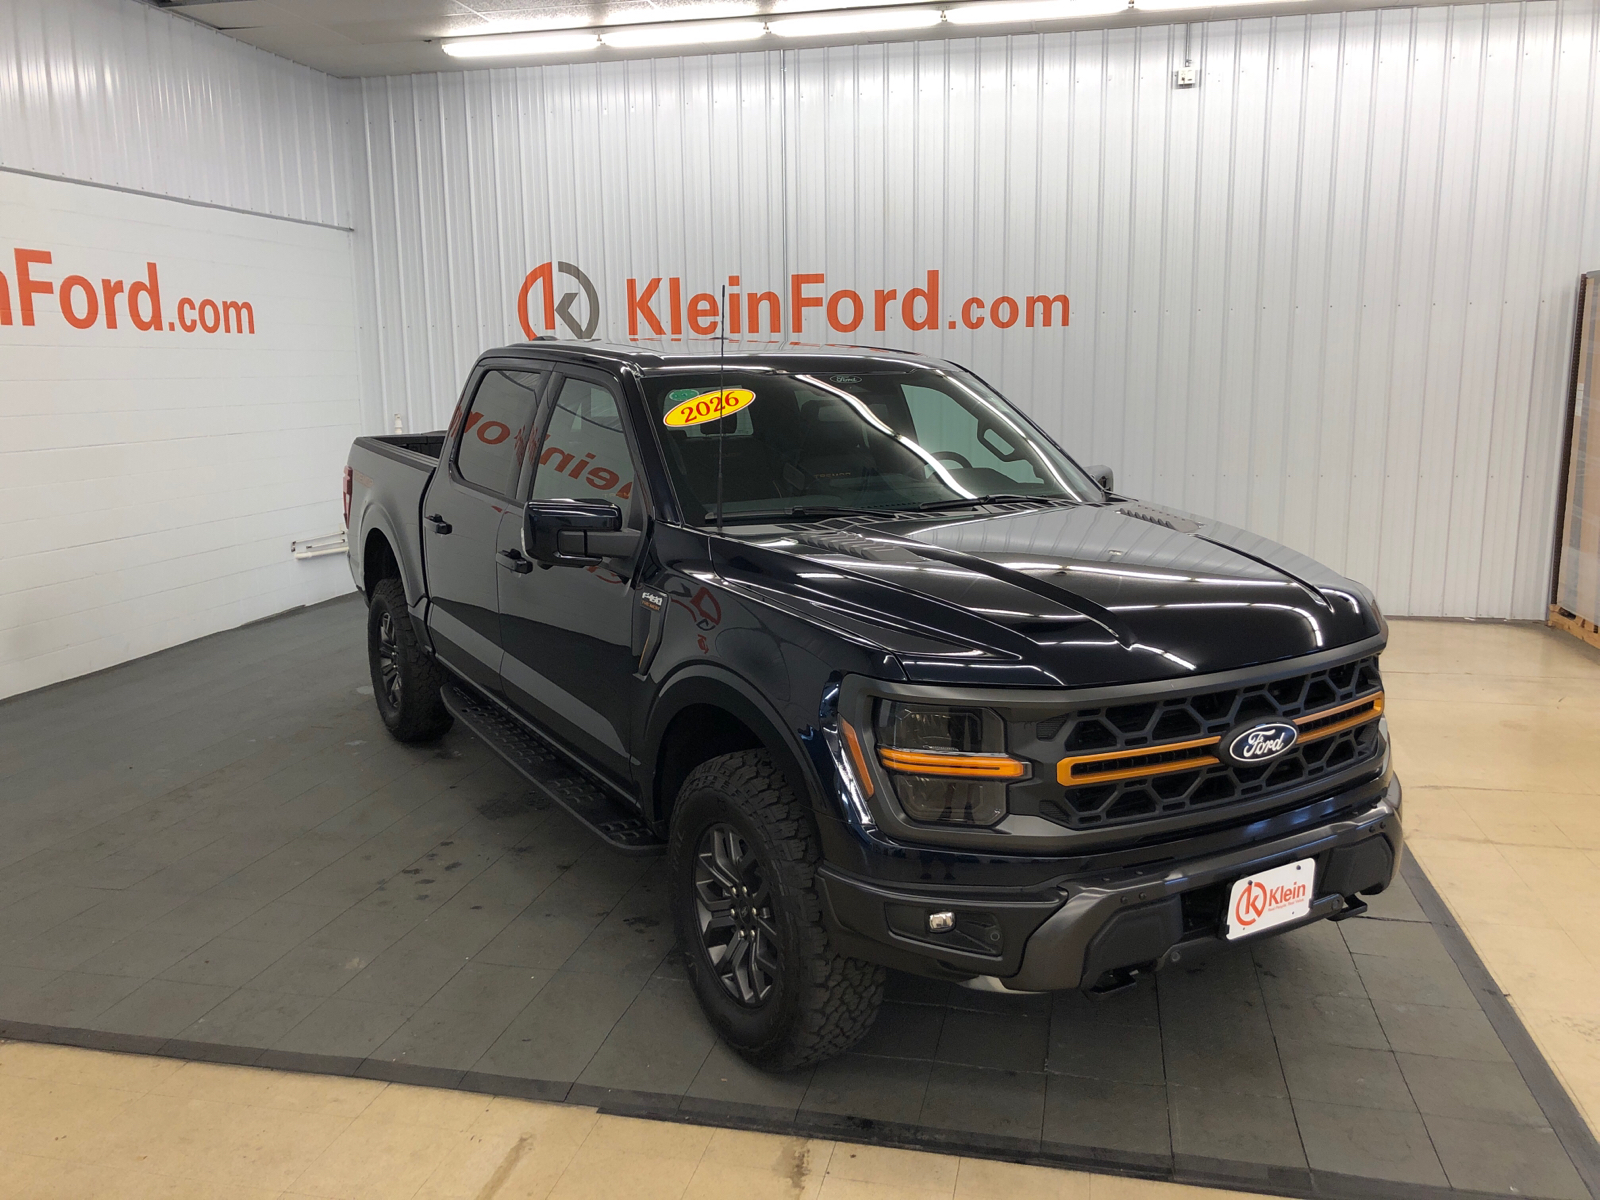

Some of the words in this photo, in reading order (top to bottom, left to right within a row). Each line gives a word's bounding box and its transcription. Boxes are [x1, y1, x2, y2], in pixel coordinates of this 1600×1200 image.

[626, 270, 1070, 336] KleinFord.com
[680, 391, 740, 423] 2026
[1243, 729, 1287, 758] Ford
[1268, 881, 1306, 907] Klein
